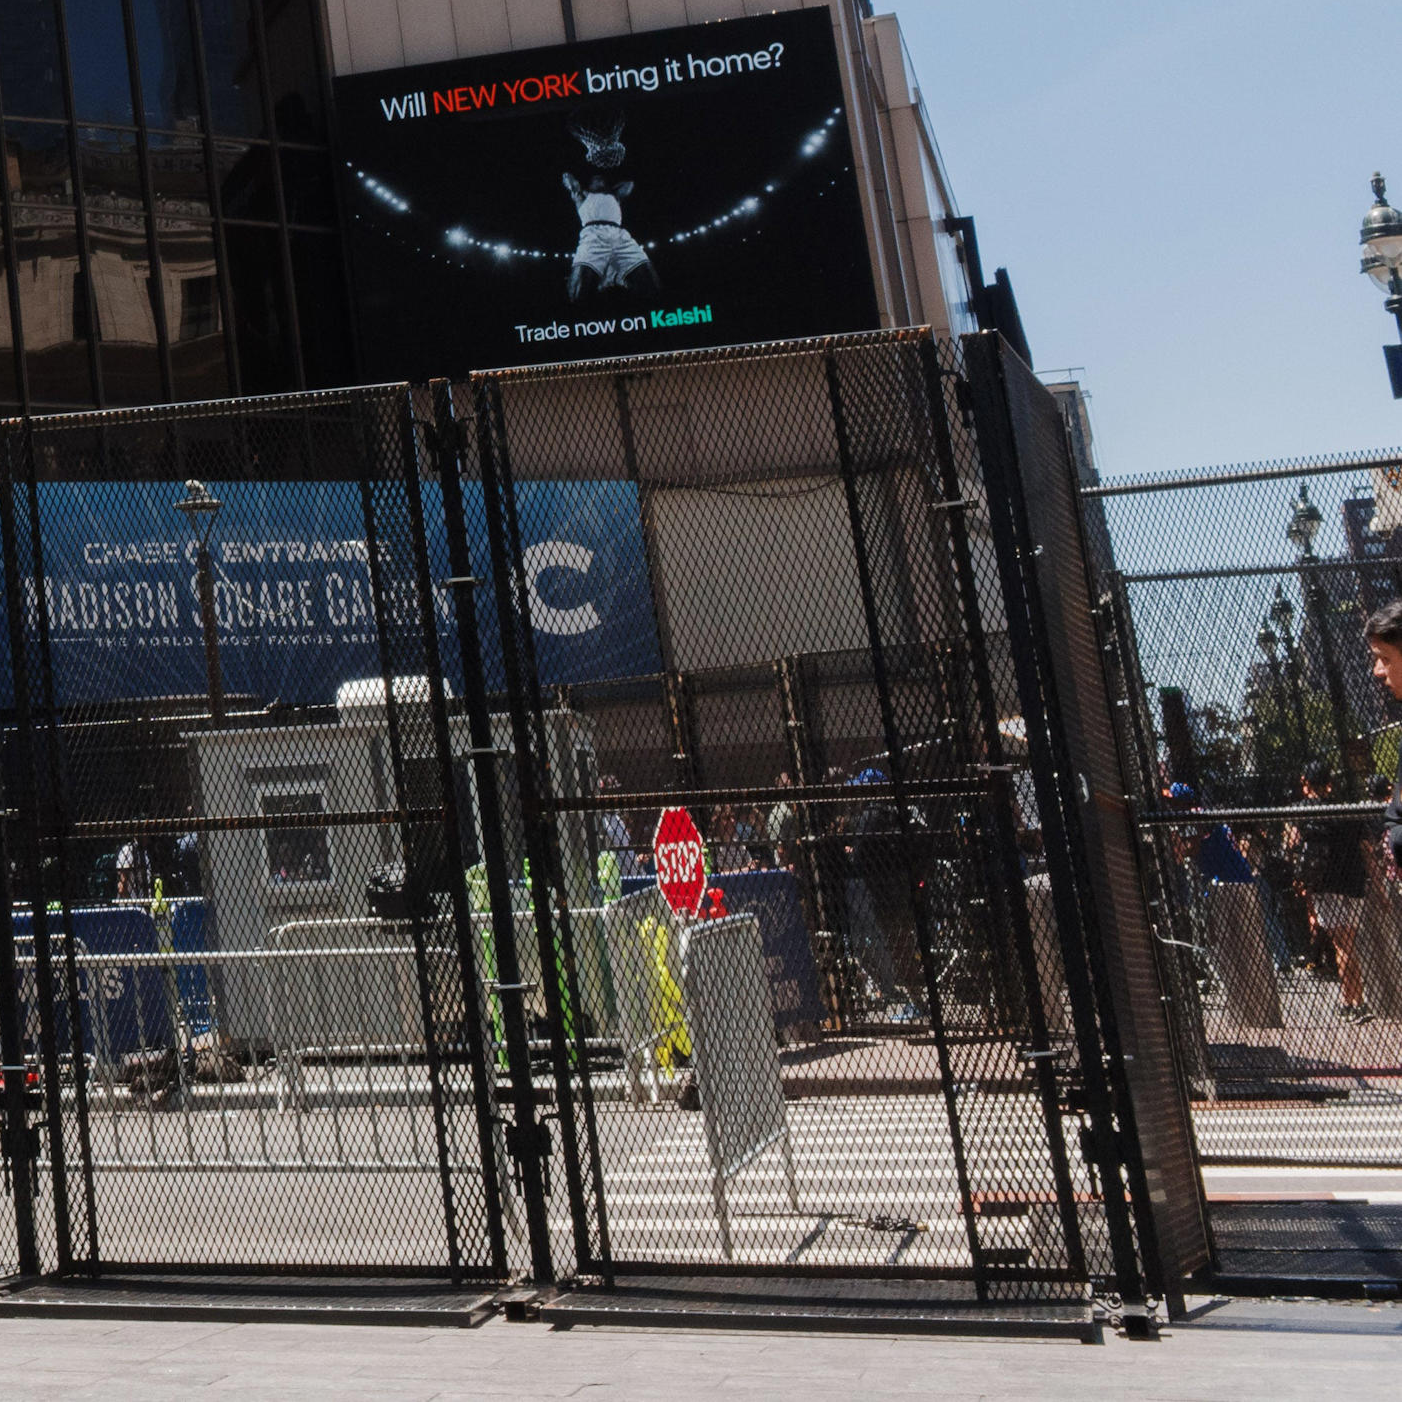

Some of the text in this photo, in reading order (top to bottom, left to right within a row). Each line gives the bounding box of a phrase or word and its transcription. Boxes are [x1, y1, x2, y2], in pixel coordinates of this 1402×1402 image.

[379, 42, 785, 122] Will NEW YORK bring it home?
[514, 304, 713, 344] Trade now on Kalshi
[83, 542, 181, 565] CHASE
[24, 575, 180, 630] MADISON
[657, 840, 701, 885] STOP
